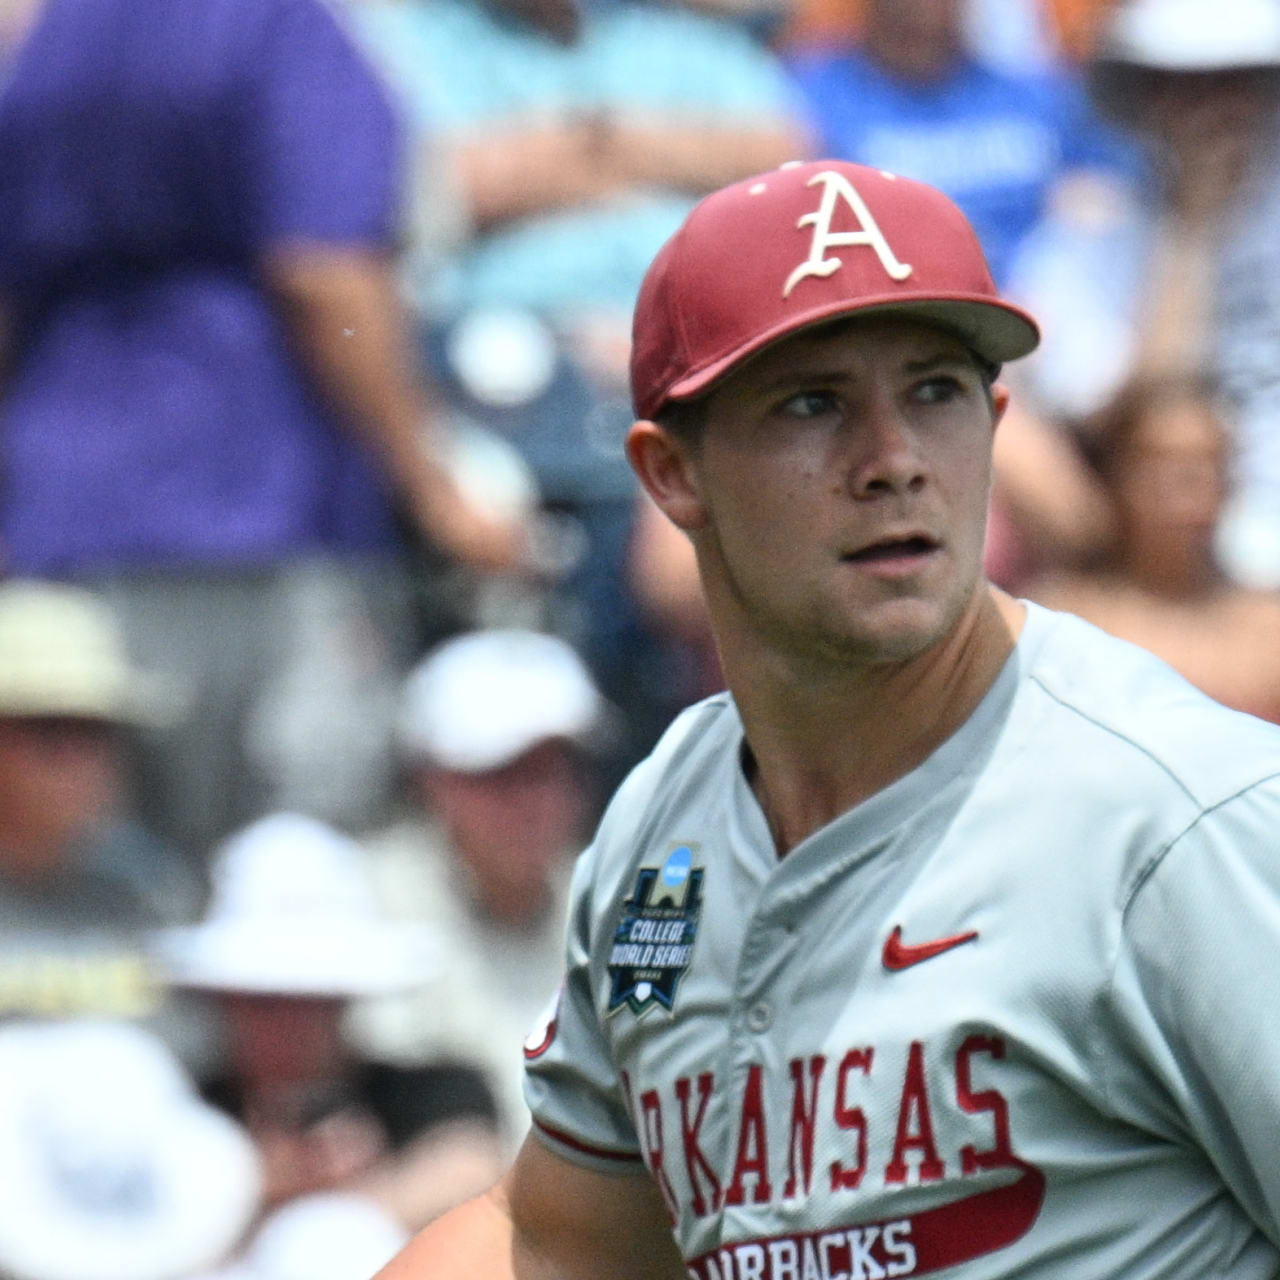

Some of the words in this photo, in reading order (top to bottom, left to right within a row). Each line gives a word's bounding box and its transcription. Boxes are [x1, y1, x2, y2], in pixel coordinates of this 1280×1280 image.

[783, 170, 913, 298] A
[630, 919, 687, 943] COLLEGE
[621, 1033, 1017, 1227] RKANSAS
